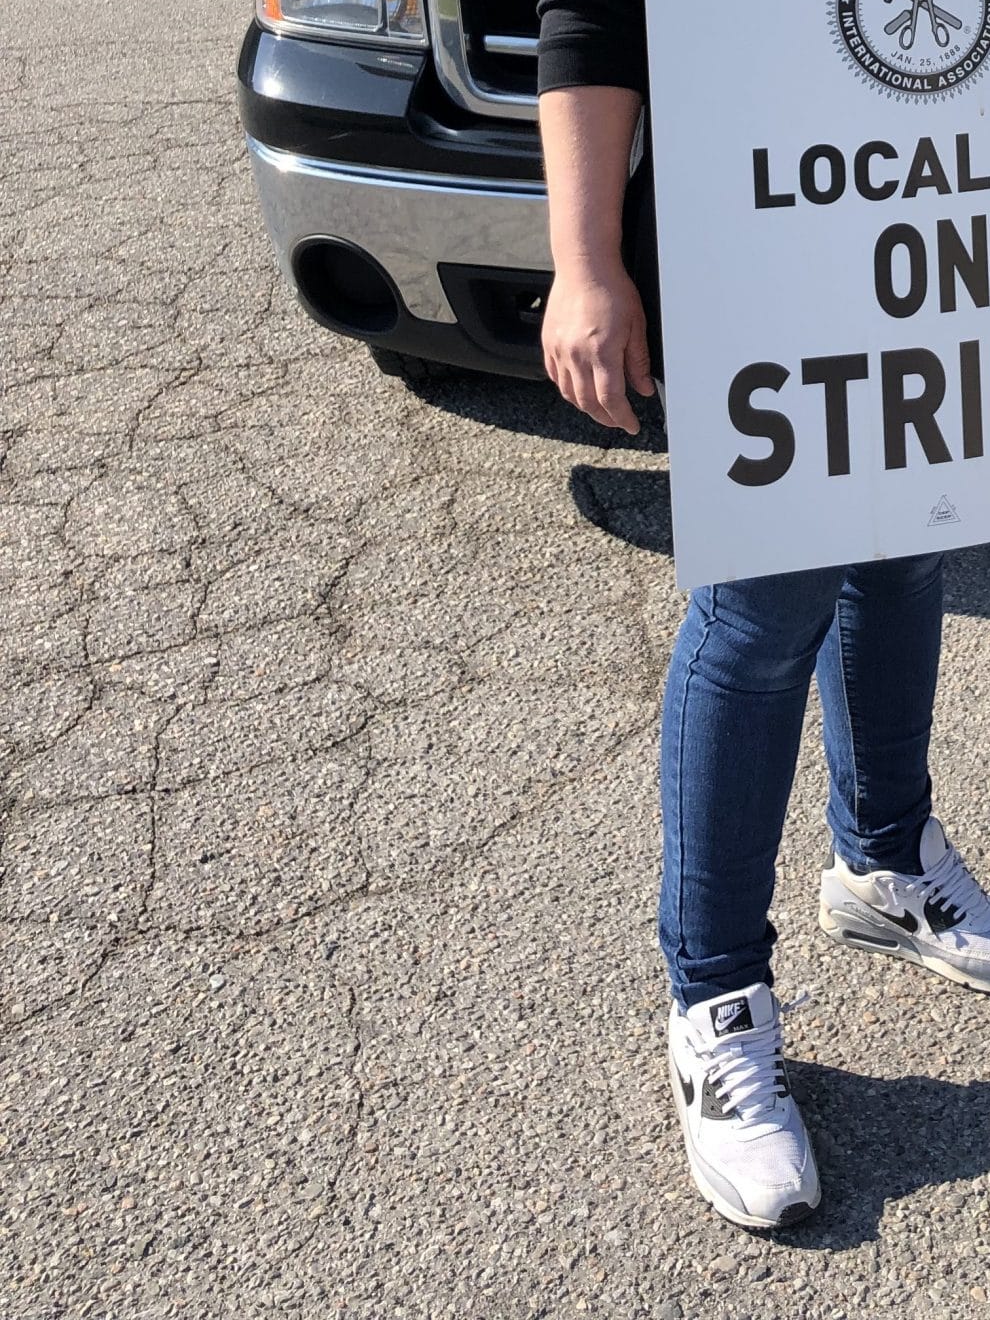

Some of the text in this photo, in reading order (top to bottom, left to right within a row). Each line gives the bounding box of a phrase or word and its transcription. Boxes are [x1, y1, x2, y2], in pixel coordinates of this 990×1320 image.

[842, 11, 932, 90] INTERNATIONAL
[891, 51, 915, 66] JAN.
[920, 58, 936, 67] 25,
[873, 214, 990, 319] ON
[717, 1002, 741, 1019] NIKE
